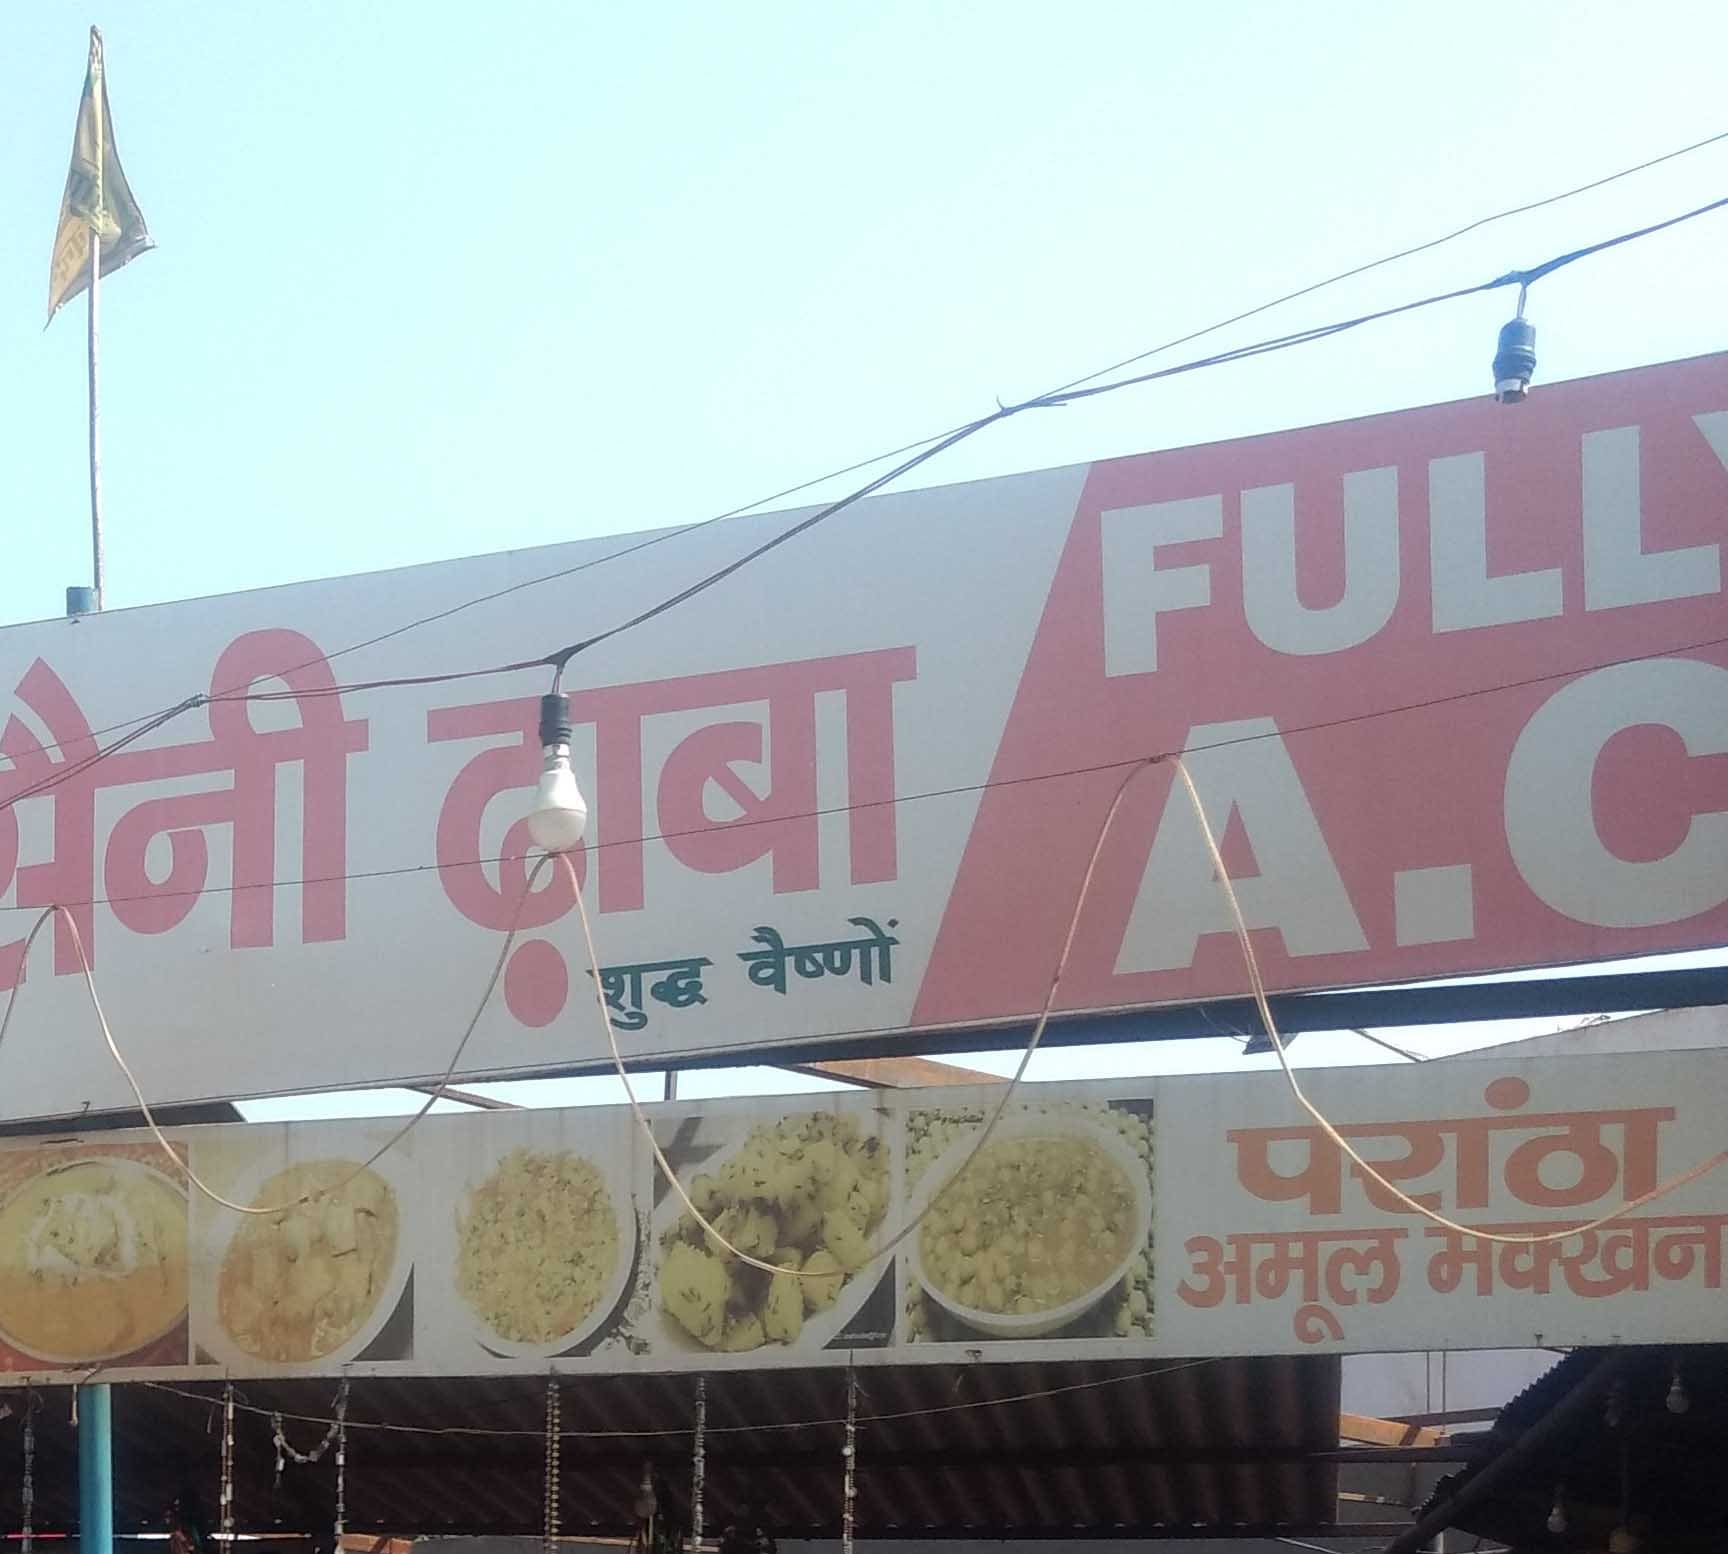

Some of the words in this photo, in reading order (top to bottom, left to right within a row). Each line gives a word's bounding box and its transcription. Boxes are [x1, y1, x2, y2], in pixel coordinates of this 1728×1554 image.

[1100, 408, 1728, 679] FULL
[586, 956, 714, 1031] शुद्ध
[1226, 1075, 1676, 1216] परांठा
[1176, 1227, 1409, 1344] अमूल
[1423, 1213, 1728, 1299] मक्खन
